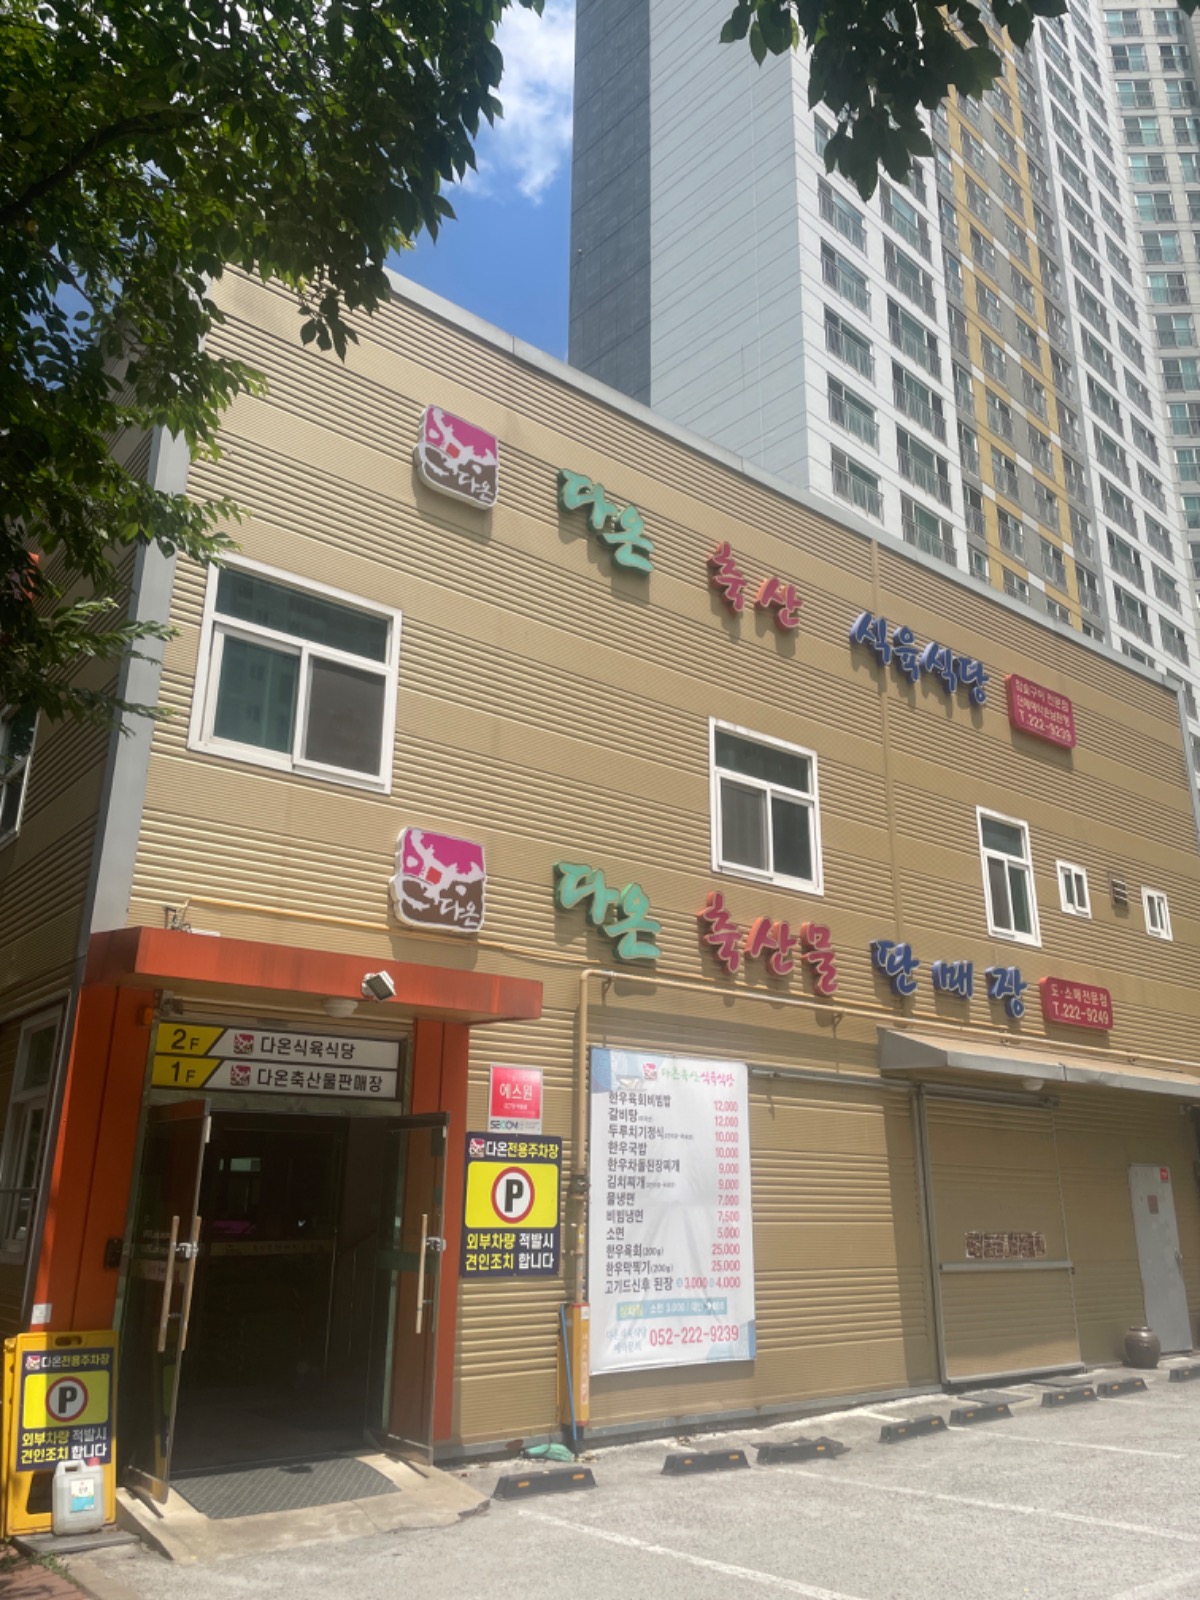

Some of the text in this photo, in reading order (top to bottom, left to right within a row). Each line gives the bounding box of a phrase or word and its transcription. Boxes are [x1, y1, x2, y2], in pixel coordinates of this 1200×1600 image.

[458, 469, 496, 504] 다온
[558, 468, 990, 704] 다온 축산 식육식당
[438, 896, 482, 928] 다온
[554, 861, 661, 961] 다온
[700, 890, 838, 996] 축산물
[171, 1029, 200, 1051] 2F
[260, 1036, 355, 1060] 다온식육식당
[170, 1062, 196, 1083] 1F
[256, 1068, 383, 1093] 다온축산물판매장
[499, 1082, 533, 1101] 에스원
[609, 1090, 671, 1108] 한우육회비빔밥
[608, 1107, 638, 1123] 갈비탕
[608, 1124, 664, 1140] 두루치기정식
[608, 1141, 647, 1156] 한우국밥
[607, 1174, 646, 1189] 김치찌개
[504, 1179, 524, 1213] P
[606, 1191, 635, 1206] 물냉면
[606, 1209, 644, 1224] 비빔냉면
[467, 1233, 554, 1250] 외부차량 적발시
[606, 1226, 624, 1241] 소면
[465, 1253, 554, 1271] 견인조치 합니다
[605, 1277, 650, 1294] 고기드신후
[653, 1276, 673, 1291] 된장
[649, 1324, 739, 1347] 052-222-9239
[58, 1386, 78, 1414] P
[22, 1427, 107, 1447] 외부차량 적발시
[21, 1443, 107, 1464] 견인조치 합니다
